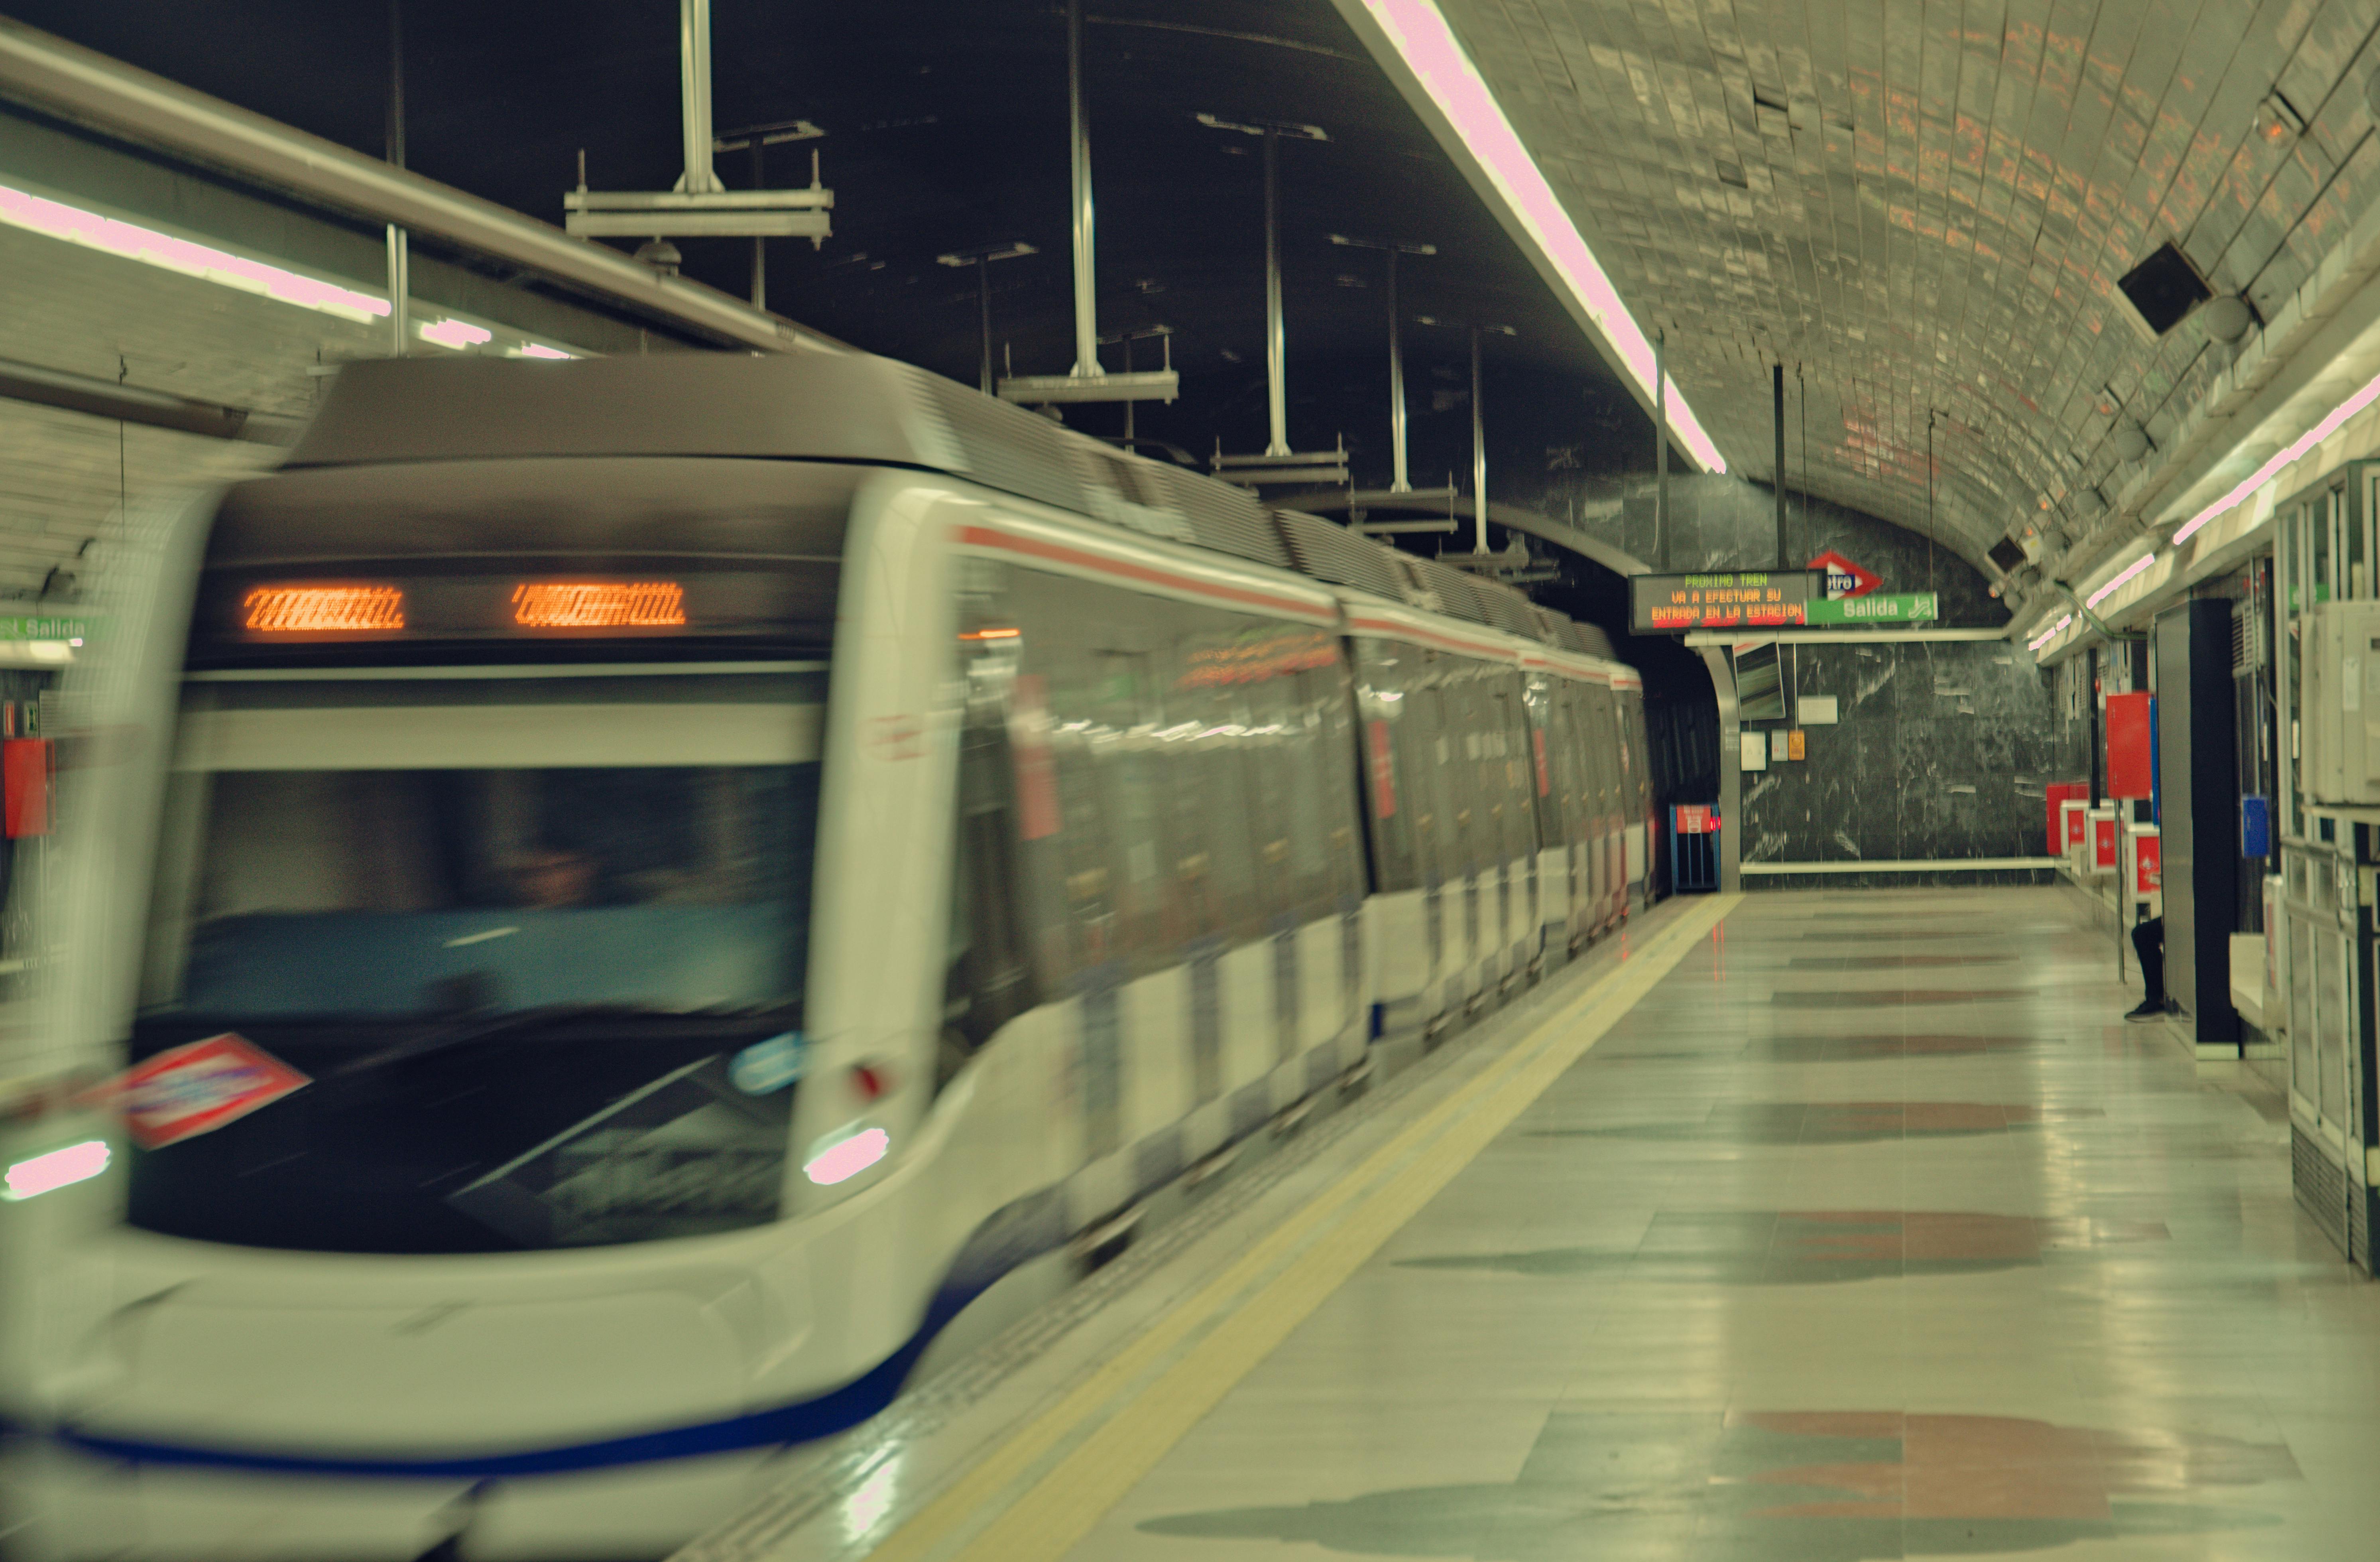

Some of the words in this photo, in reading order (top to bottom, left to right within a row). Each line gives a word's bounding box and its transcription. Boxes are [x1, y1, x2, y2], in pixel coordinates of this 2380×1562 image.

[1686, 574, 1733, 587] PROXIMO
[1740, 573, 1767, 586] TREN
[1827, 575, 1852, 590] etro
[1672, 590, 1686, 604] VA
[1692, 590, 1699, 603] A
[1705, 588, 1760, 603] EFECTUAR
[1766, 588, 1781, 601] SU
[1652, 605, 1699, 620] ENTRADA
[1706, 605, 1720, 618] EN
[1726, 605, 1740, 618] LA
[1747, 603, 1801, 618] ESTACION
[1844, 597, 1898, 617] Salida
[26, 618, 85, 638] Salida
